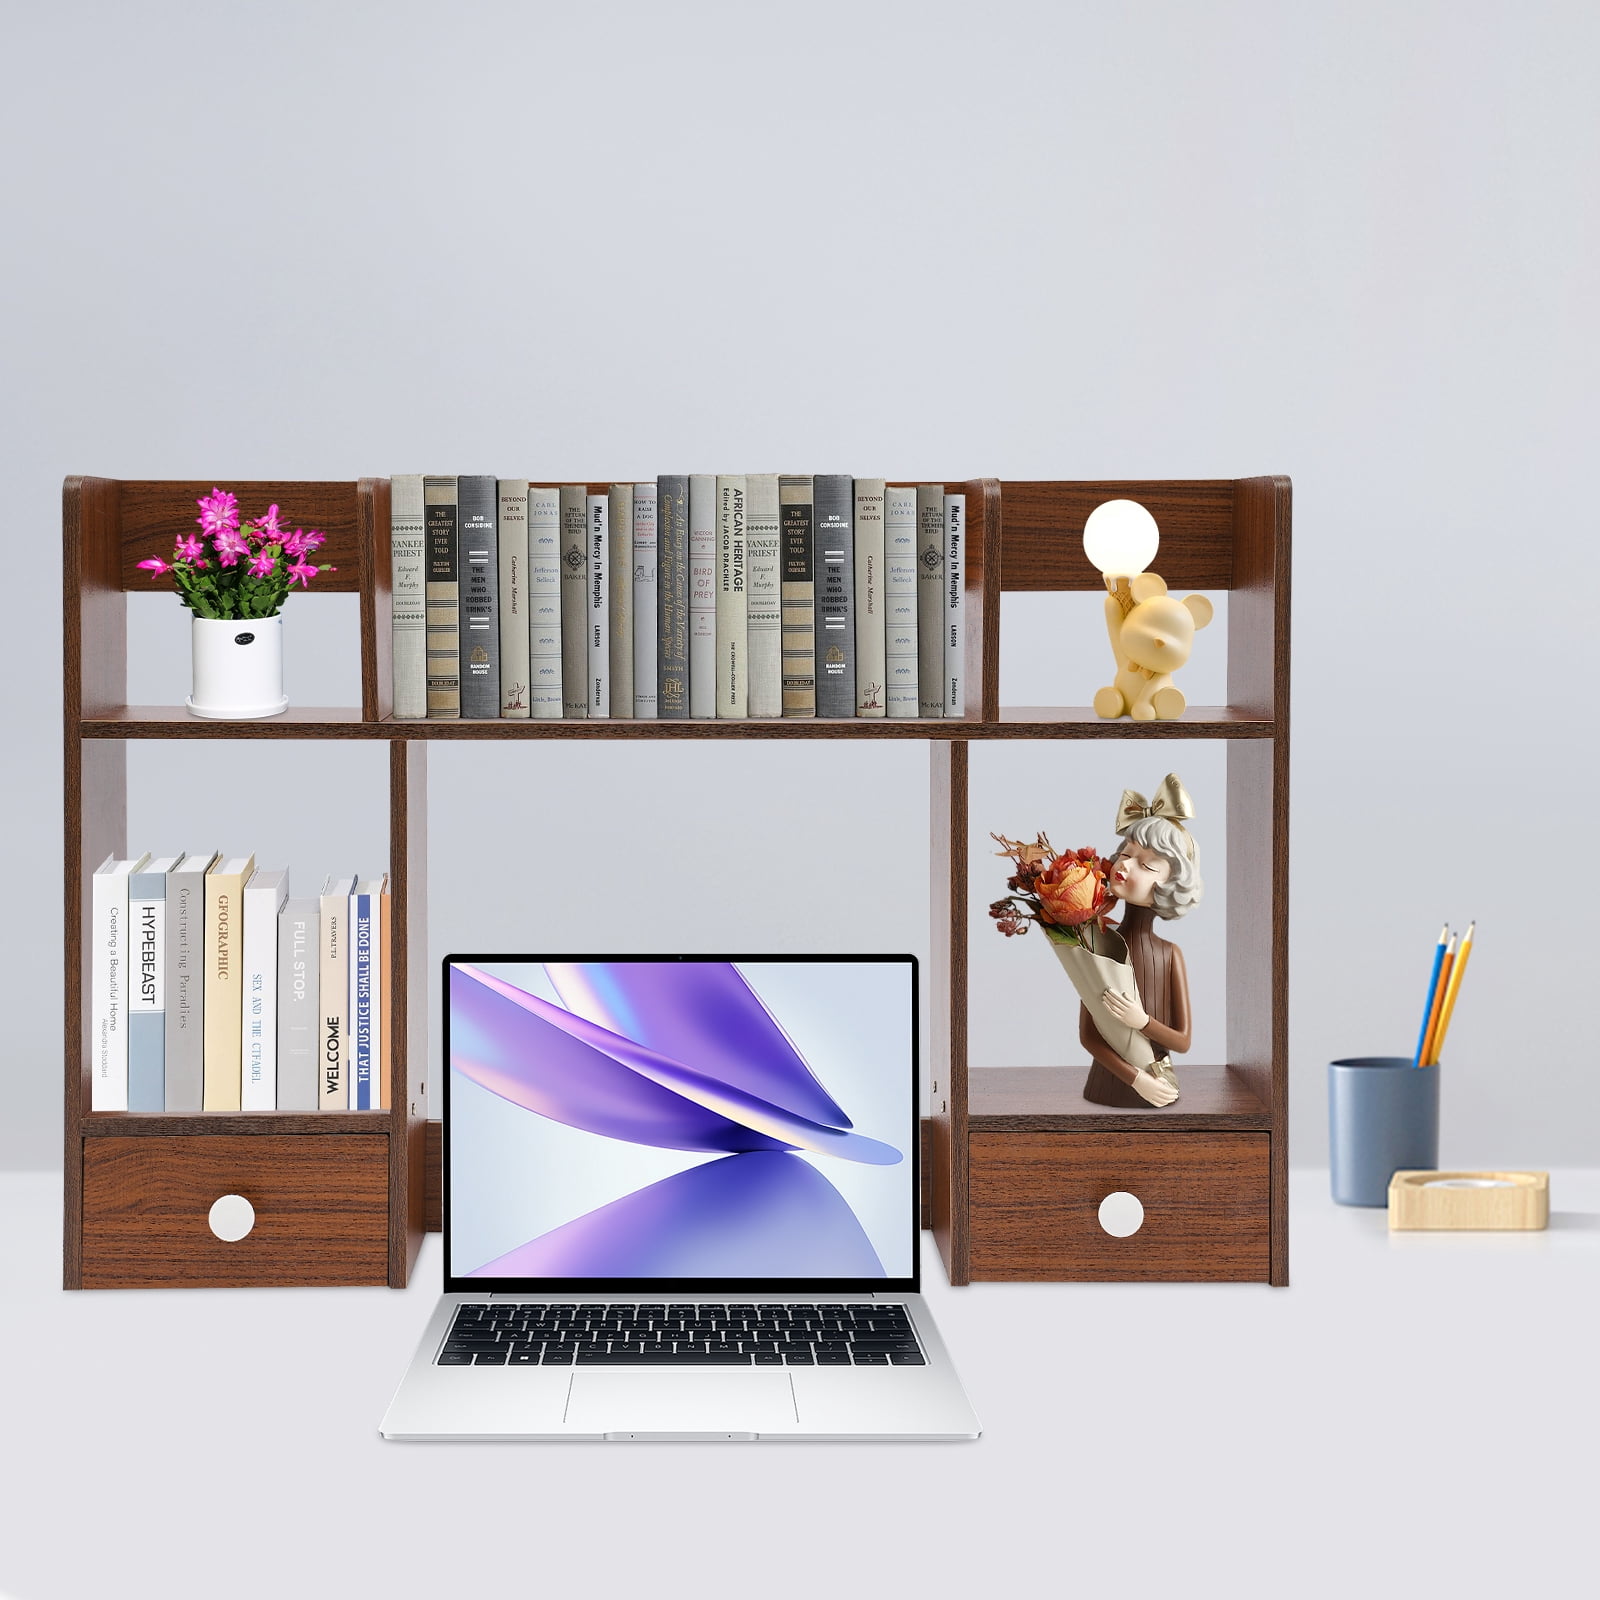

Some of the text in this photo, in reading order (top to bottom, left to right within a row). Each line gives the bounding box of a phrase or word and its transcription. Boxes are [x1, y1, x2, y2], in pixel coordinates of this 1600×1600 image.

[662, 494, 673, 536] Complexion
[676, 513, 685, 526] An
[722, 513, 730, 523] by
[392, 540, 424, 548] YANKEE
[664, 537, 673, 552] and
[673, 528, 685, 549] Essay
[734, 489, 743, 592] AFRICAN HERITAGE
[747, 540, 779, 548] YANKEE
[393, 550, 422, 558] PRIEST
[592, 506, 602, 608] Mud'n Mercy In Memphis
[676, 551, 683, 561] on
[949, 506, 960, 608] Mud'n Mercy In Memphis
[676, 562, 685, 573] the
[694, 568, 712, 576] BIRD
[398, 582, 419, 590] Murphy
[471, 576, 486, 584] MEN
[673, 599, 685, 610] of
[664, 603, 673, 632] Human
[676, 610, 685, 621] the
[673, 651, 685, 661] of
[108, 907, 118, 948] Creating
[142, 907, 156, 1004] HYPEBEAST
[178, 888, 190, 1029] Constructing Paradies
[293, 921, 305, 1002] FULL STOP.
[109, 959, 119, 1000] Beautiful
[252, 973, 262, 992] SEX
[252, 997, 262, 1015] AND
[358, 917, 369, 1083] THAT JUSTICE SHALL BE DONE
[109, 1003, 118, 1032] Home
[252, 1020, 261, 1037] THE
[327, 1016, 339, 1094] WELCOME
